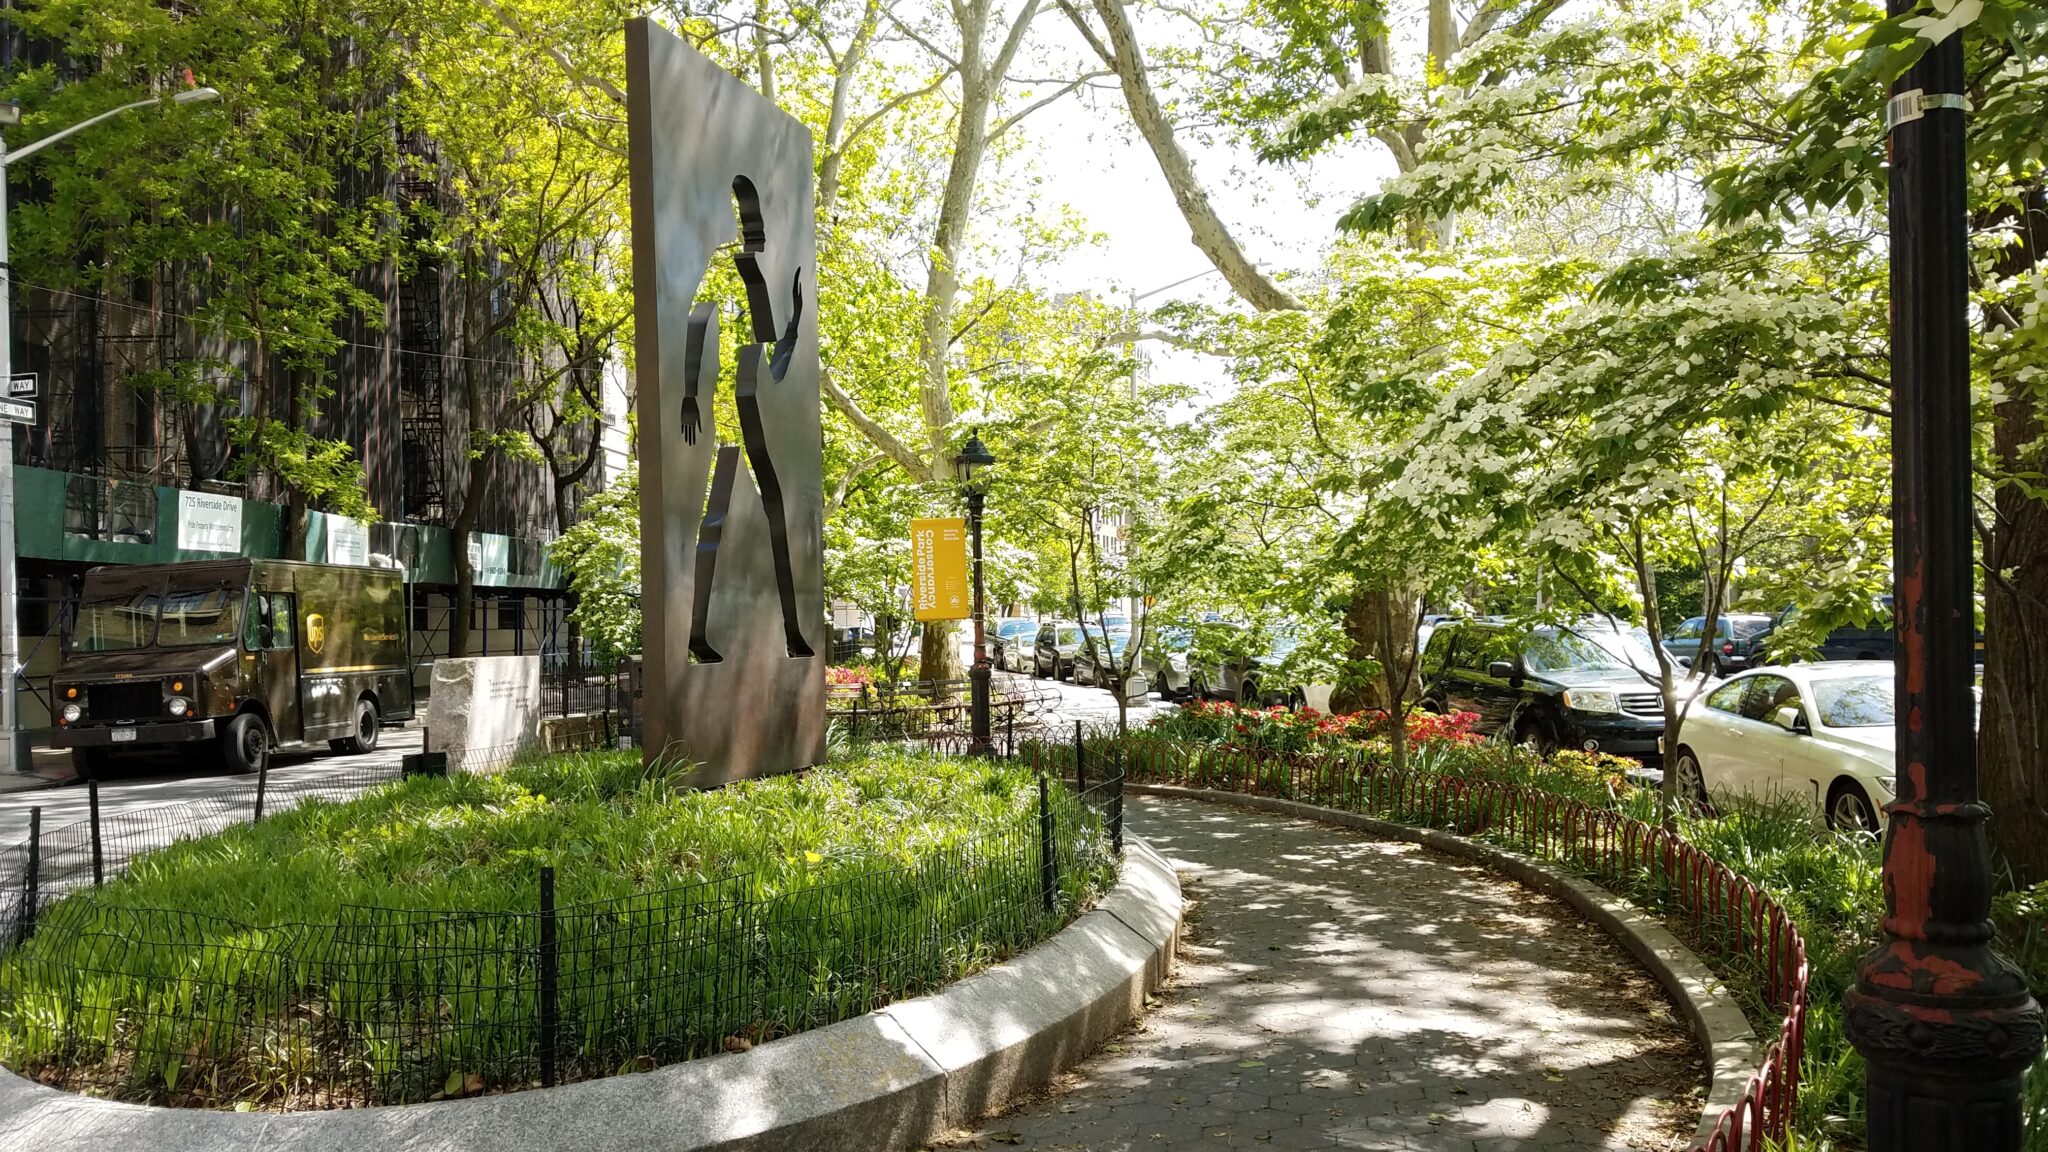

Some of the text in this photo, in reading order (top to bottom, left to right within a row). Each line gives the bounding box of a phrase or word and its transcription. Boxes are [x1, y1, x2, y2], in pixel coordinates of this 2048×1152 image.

[13, 381, 29, 390] WAY
[0, 403, 29, 416] NE WAY
[185, 496, 238, 512] 725 Riverside Drive
[916, 530, 928, 610] Riverside Park
[926, 529, 936, 609] Conservancy
